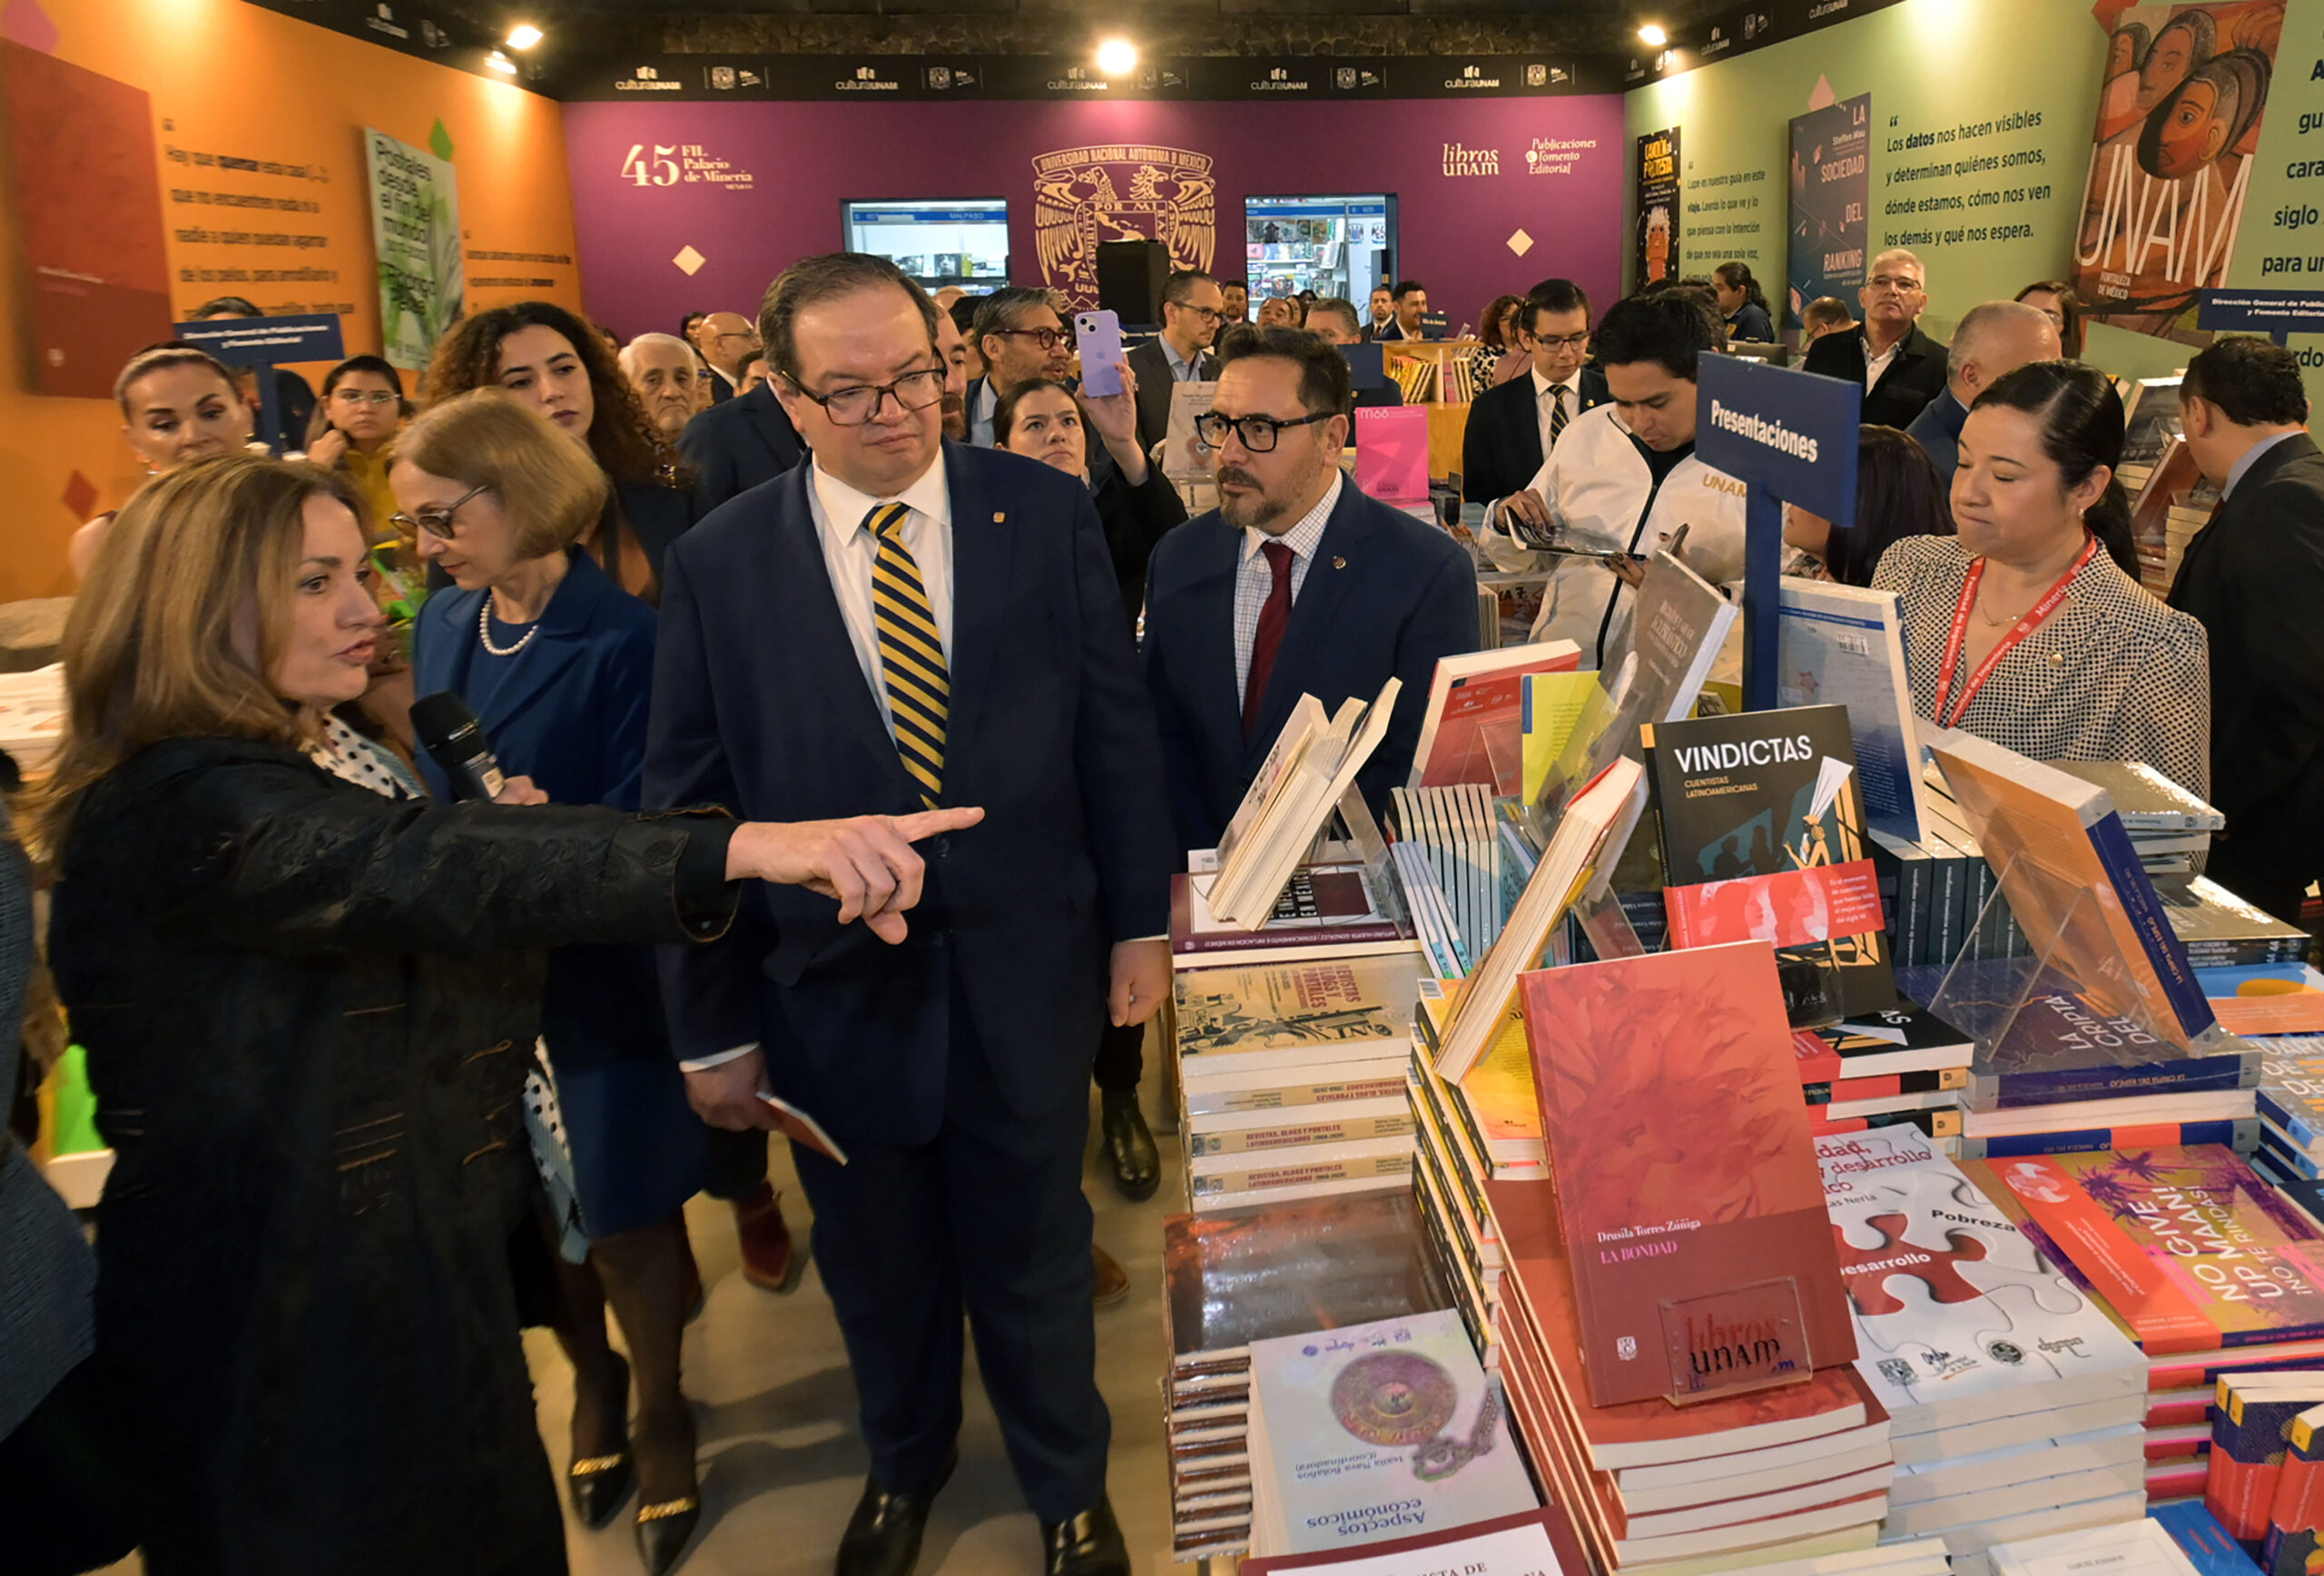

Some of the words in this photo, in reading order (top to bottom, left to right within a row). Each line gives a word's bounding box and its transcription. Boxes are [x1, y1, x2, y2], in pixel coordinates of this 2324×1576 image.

[1853, 104, 1866, 125] LA
[1887, 138, 1904, 153] Los
[1905, 132, 1935, 149] datos
[1936, 128, 1956, 143] nos
[1958, 121, 1992, 140] hacen
[1995, 110, 2043, 133] visibles
[682, 145, 708, 156] FIL
[1443, 143, 1499, 163] libros
[1532, 138, 1597, 151] Publicaciones
[1539, 150, 1580, 163] Fomento
[620, 144, 680, 186] 45
[684, 158, 730, 169] Palacio
[1040, 149, 1089, 171] UNIVERSIDAD
[1090, 147, 1127, 162] NACIONAL
[1128, 147, 1169, 163] AUTONOMA
[1178, 153, 1207, 171] MEXICO
[1529, 163, 1571, 174] Editorial
[1821, 154, 1866, 182] SOCIEDAD
[1886, 171, 1892, 186] y
[1894, 163, 1952, 183] determinan
[1955, 155, 1998, 177] quiénes
[2002, 148, 2046, 169] somos,
[684, 171, 701, 182] de
[704, 170, 753, 182] Minería
[1094, 202, 1123, 211] POR
[1134, 202, 1157, 211] MI
[1885, 198, 1915, 215] dónde
[1918, 194, 1965, 212] estamos,
[1968, 190, 2000, 207] cómo
[2003, 188, 2024, 203] nos
[2028, 184, 2051, 200] ven
[1846, 202, 1864, 223] DEL
[2075, 143, 2254, 288] UNAM
[2274, 204, 2318, 230] siglo
[1885, 231, 1898, 246] los
[1900, 229, 1933, 245] demás
[1935, 231, 1942, 246] y
[1944, 226, 1965, 245] qué
[1967, 228, 1987, 241] nos
[1991, 223, 2034, 241] espera.
[1823, 249, 1863, 272] RANKING
[2262, 255, 2301, 276] para
[2098, 283, 2106, 295] DE
[2106, 285, 2129, 300] MÉXICO
[2212, 297, 2250, 306] Dirección
[2253, 299, 2285, 308] General
[2287, 300, 2298, 308] de
[1710, 399, 1818, 464] Presentaciones
[1960, 576, 1975, 612] Facultad
[2035, 585, 2067, 617] Minería
[1956, 612, 1965, 625] de
[1971, 677, 1980, 687] de
[1674, 734, 1813, 773] VINDICTAS
[1684, 775, 1729, 789] CUENTISTAS
[1686, 783, 1758, 799] LATINOAMERICANAS
[1302, 968, 1327, 1008] PORTALES
[1334, 965, 1362, 1002] REVISTAS
[2045, 995, 2122, 1047] CRIPTA
[2108, 1017, 2157, 1045] DEL
[2058, 1032, 2094, 1049] LA
[1281, 1128, 1302, 1138] BLOGS
[1308, 1124, 1341, 1134] PORTALES
[1283, 1168, 1304, 1178] BLOGS
[1310, 1164, 1343, 1174] PORTALES
[1832, 1149, 1933, 1176] desarrollo
[1597, 1227, 1633, 1243] Drusila
[1634, 1223, 1665, 1237] Torres
[1667, 1217, 1701, 1233] Zúñiga
[1931, 1209, 2017, 1233] Pobreza
[2127, 1198, 2199, 1258] GIVE
[1600, 1250, 1619, 1265] LA
[1620, 1241, 1678, 1261] BONDAD
[1840, 1252, 1931, 1276] esarrollo
[2249, 1245, 2276, 1263] TE
[2193, 1264, 2249, 1302] NO
[2233, 1266, 2284, 1299] UP
[1686, 1314, 1778, 1351] libros
[1295, 1452, 1377, 1472] (Coordinadora)
[1296, 1466, 1342, 1480] Bolaños
[1344, 1462, 1371, 1473] Nava
[1306, 1498, 1423, 1529] económicos
[1337, 1511, 1425, 1536] Aspectos
